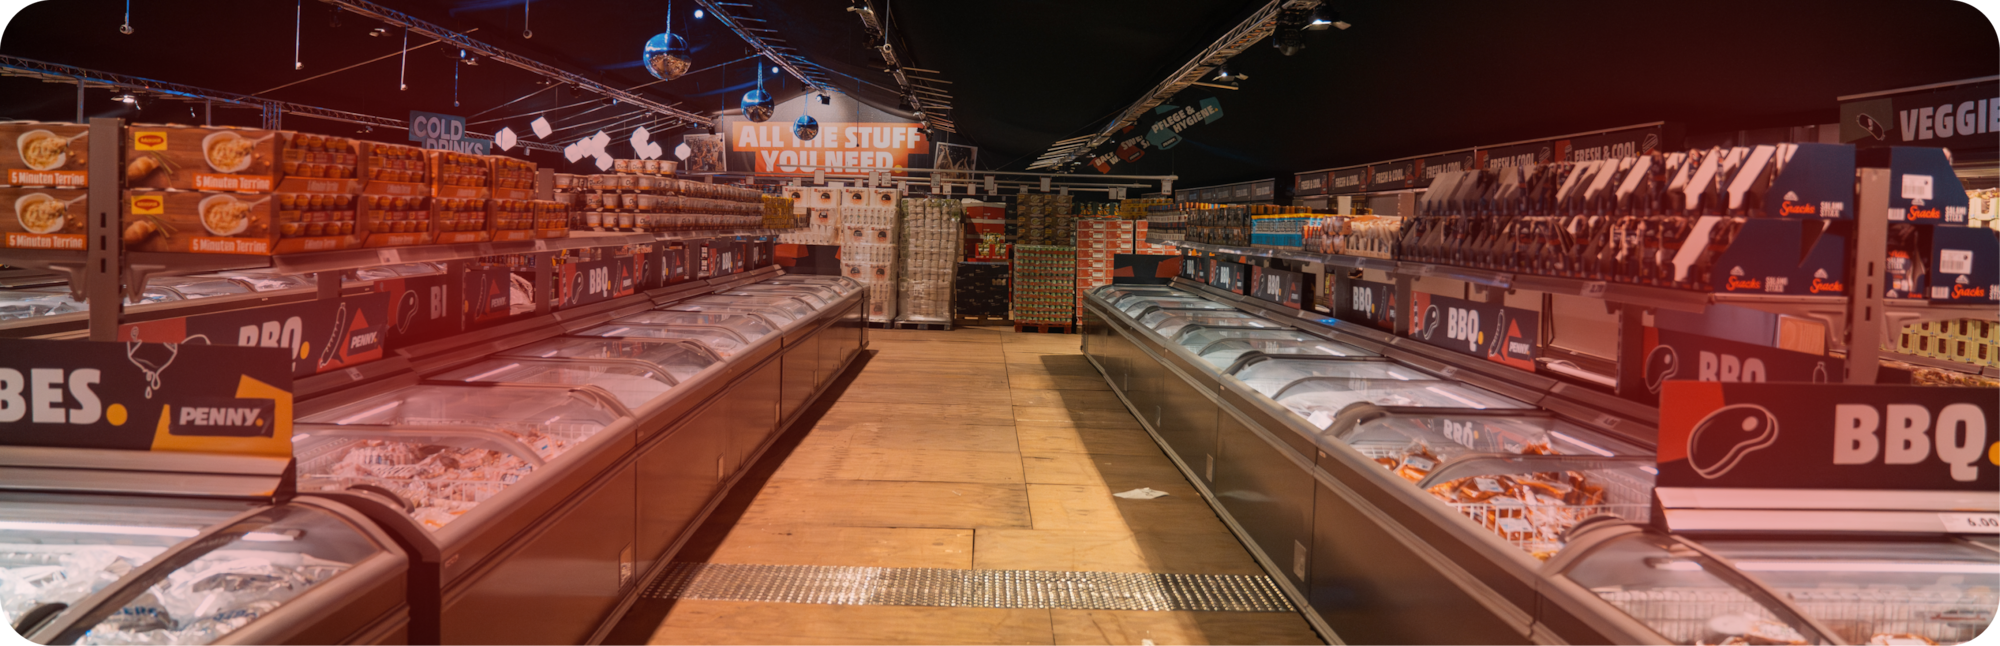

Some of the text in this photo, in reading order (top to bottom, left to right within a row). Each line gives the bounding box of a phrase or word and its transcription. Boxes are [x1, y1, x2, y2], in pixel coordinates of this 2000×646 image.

[414, 115, 463, 140] COLD
[1151, 105, 1195, 134] PFLEGE &
[1172, 105, 1218, 133] HYGIENE.
[1900, 97, 2000, 142] VEGGIE
[739, 126, 784, 148] ALL
[845, 127, 920, 149] STUFF
[761, 150, 903, 174] YOU NEED.
[1490, 156, 1510, 168] FRESH
[1574, 141, 1640, 162] FRESH & COOL.
[11, 172, 85, 186] 5 Minuten Terrine
[1426, 163, 1442, 179] FRESH
[196, 175, 270, 190] 5 Minuten Terrine
[1779, 200, 1815, 216] Snacks
[1907, 205, 1941, 221] Snacks
[9, 235, 83, 249] 5 Minuten Terrine
[193, 238, 267, 254] 5 Minuten Terrine
[589, 266, 611, 297] BBQ.
[1267, 274, 1281, 301] BBQ.
[1726, 275, 1761, 291] Snacks
[1951, 284, 1984, 299] Snacks
[1352, 286, 1375, 320] BBQ.
[1447, 306, 1484, 352] BBQ.
[350, 331, 378, 349] PENNY.
[1508, 341, 1530, 355] PENNY.
[0, 368, 128, 427] BES.
[179, 406, 264, 428] PENNY.
[1833, 403, 2000, 481] BBQ.
[1968, 518, 1998, 527] 6.00
